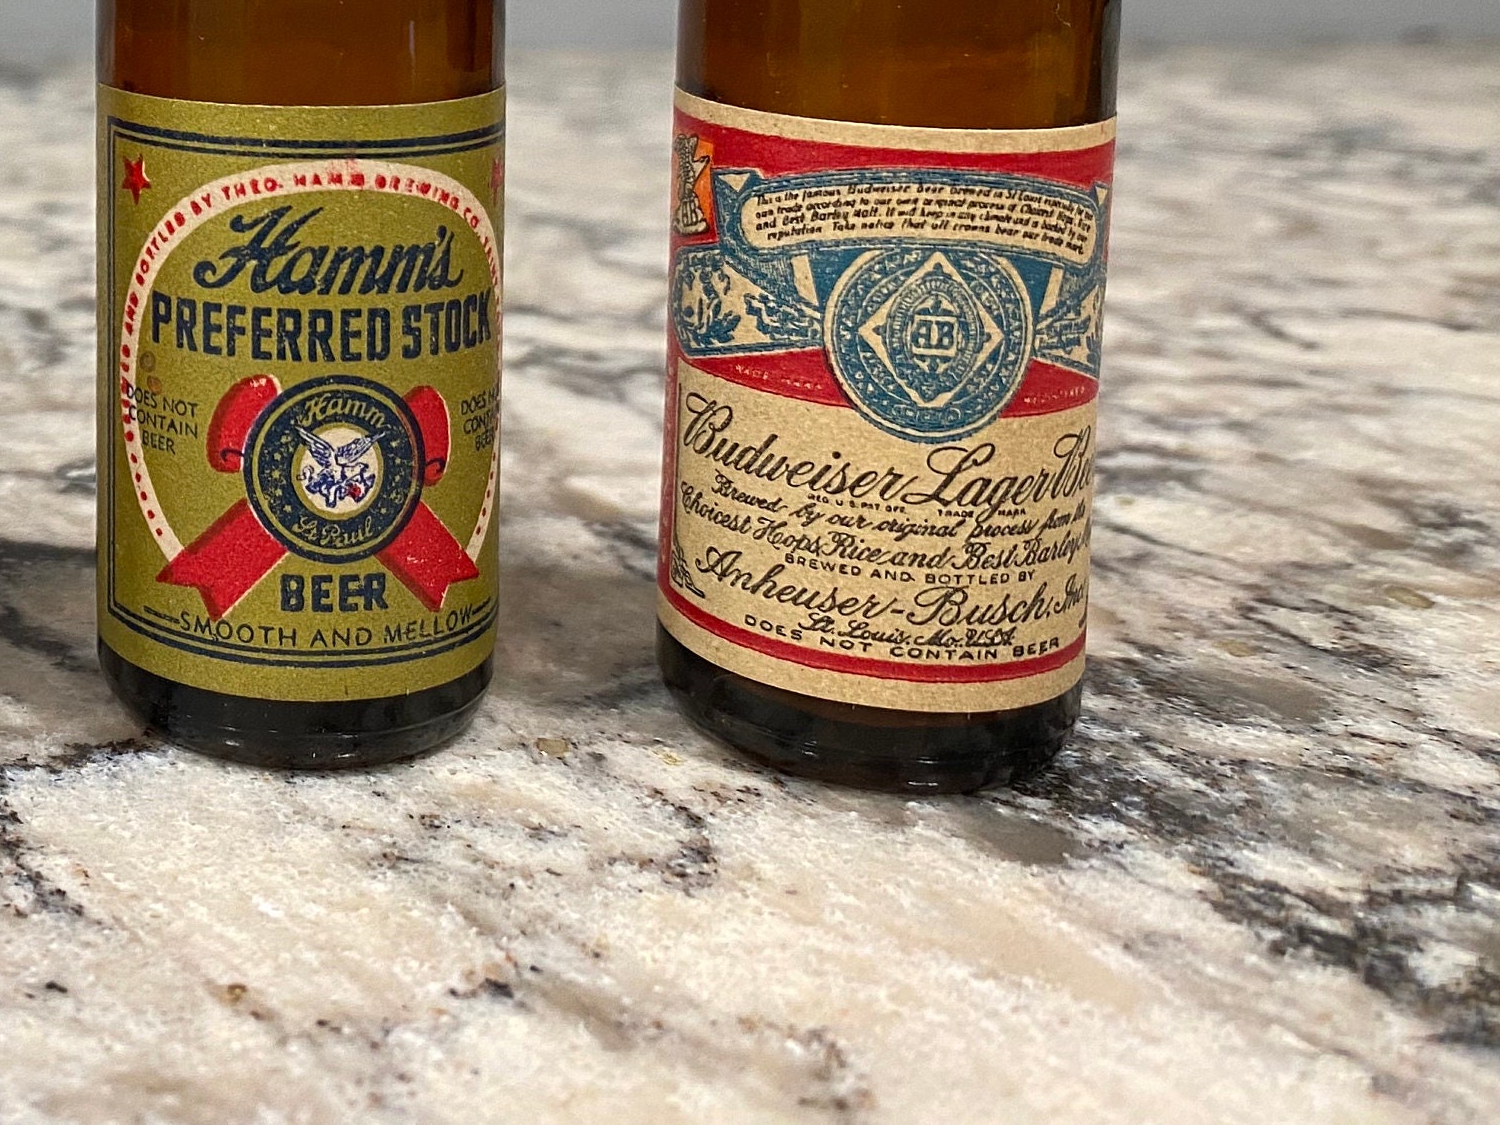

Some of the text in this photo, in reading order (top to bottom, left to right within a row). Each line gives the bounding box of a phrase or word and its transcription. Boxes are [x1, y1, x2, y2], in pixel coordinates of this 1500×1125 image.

[784, 192, 799, 201] the
[802, 189, 842, 201] famous
[847, 183, 911, 195] Budweiser
[859, 196, 869, 206] to
[755, 218, 777, 231] and
[901, 218, 927, 229] that
[192, 204, 465, 296] Hamm's
[151, 290, 391, 363] PREFERRED
[401, 289, 493, 361] STOCK
[126, 384, 199, 419] DOES NOT
[128, 404, 199, 439] CONTAIN
[141, 430, 176, 455] BEER
[683, 391, 918, 501] Budweiser
[900, 442, 1050, 526] Lager
[711, 469, 788, 514] Brewed
[789, 502, 827, 527] by
[825, 513, 876, 531] our
[872, 518, 966, 542] original
[965, 518, 1040, 544] process
[1035, 507, 1072, 540] from
[937, 508, 1027, 519] TRADE MARK
[681, 481, 752, 535] Choicest
[821, 531, 892, 566] Rice
[886, 546, 956, 570] and
[951, 541, 1018, 570] Best
[784, 552, 1036, 586] BREWED AND BOTTLED BY
[280, 572, 389, 613] BEER
[179, 604, 474, 647] SMOOTH AND MELLOW
[744, 614, 1060, 661] DOES NOT CONTAIN BEER
